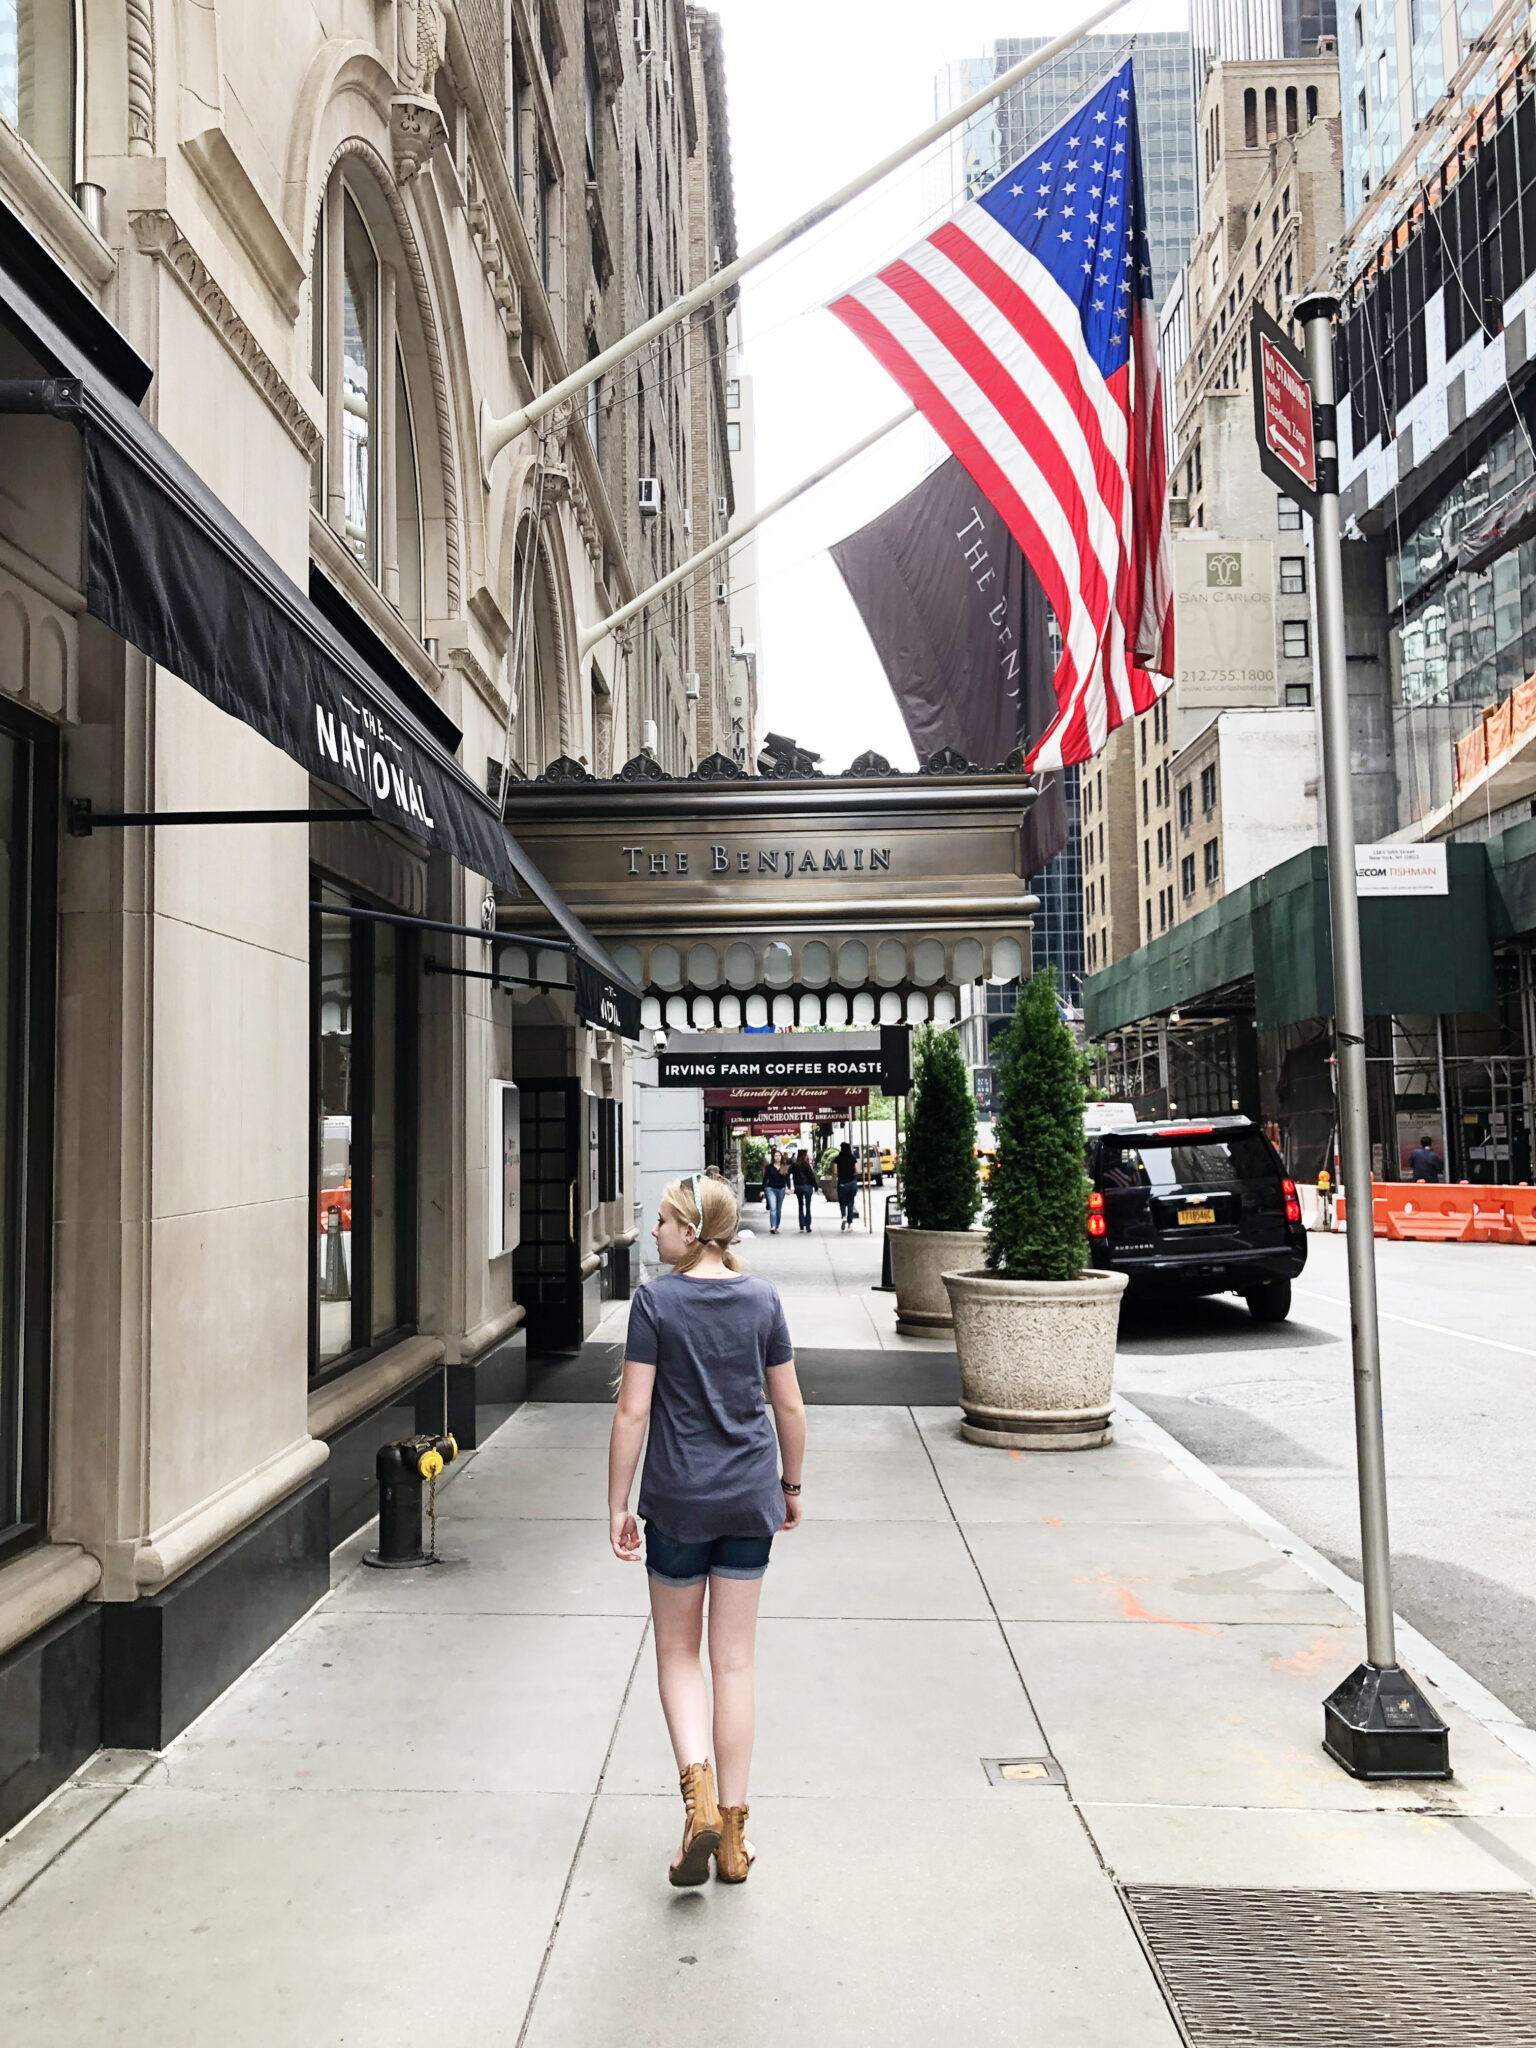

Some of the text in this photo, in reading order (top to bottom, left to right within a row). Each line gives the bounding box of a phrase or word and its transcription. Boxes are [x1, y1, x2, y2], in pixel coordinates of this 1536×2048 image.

[1265, 348, 1307, 409] NO STANDING
[1265, 375, 1281, 403] Hotel
[1267, 396, 1307, 448] Loading Zone
[956, 506, 997, 593] THE
[1212, 592, 1272, 603] CARLOS
[1181, 670, 1274, 682] 212.755.1800
[361, 706, 385, 741] THE
[316, 704, 434, 828] NATIONAL
[622, 845, 891, 878] THE BENJAMIN
[1389, 867, 1437, 877] TISHMAN
[665, 1064, 716, 1076] IRVING
[721, 1064, 760, 1075] FARM
[765, 1063, 822, 1074] COFFEE
[729, 1088, 788, 1104] Randolph
[791, 1088, 828, 1096] House
